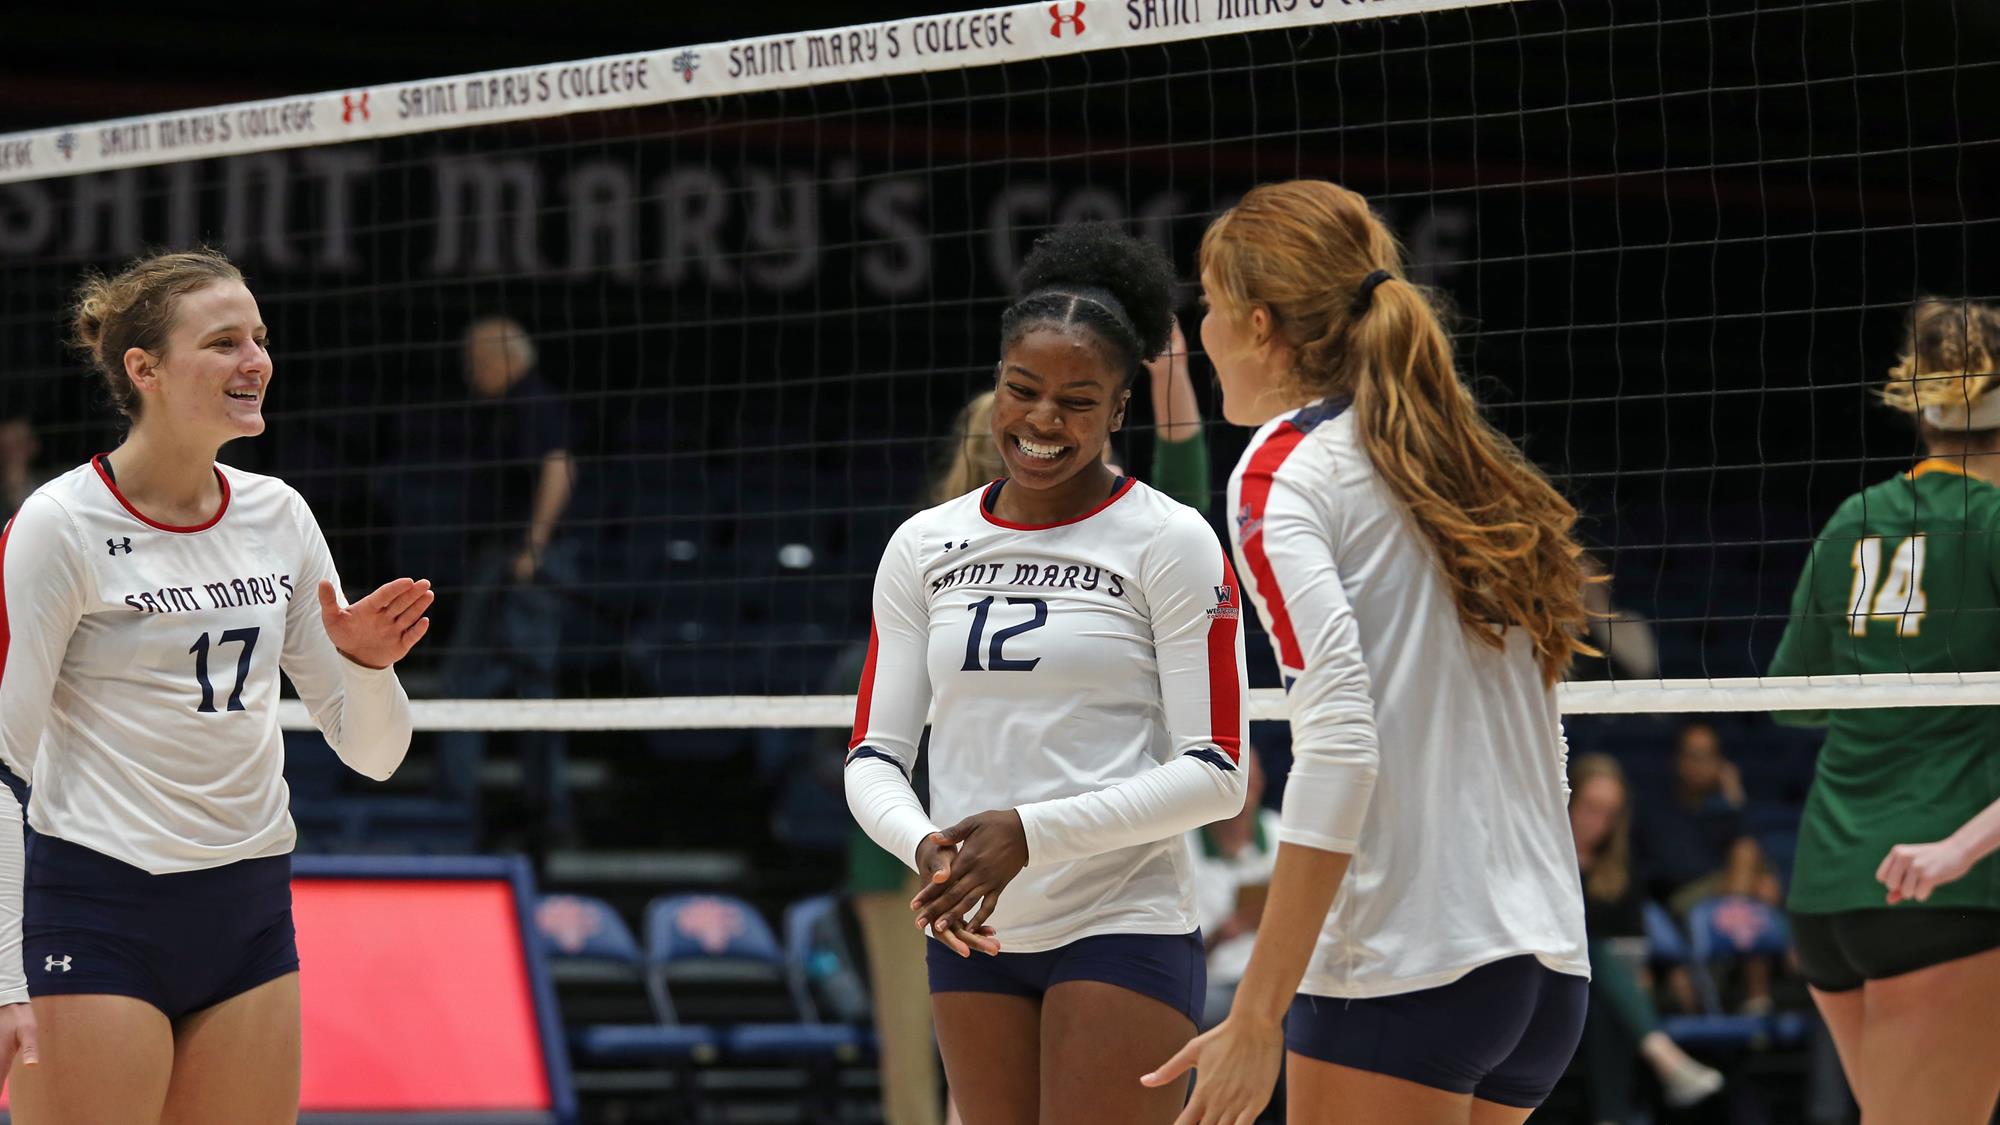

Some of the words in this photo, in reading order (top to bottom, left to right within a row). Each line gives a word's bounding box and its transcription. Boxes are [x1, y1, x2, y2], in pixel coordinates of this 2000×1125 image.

[727, 39, 797, 78] SAINT
[806, 25, 900, 68] MARY'S
[912, 11, 1015, 53] COLLEGE
[400, 82, 458, 119] SAINT
[465, 69, 551, 110] MARY'S
[557, 58, 649, 99] COLLEGE
[99, 122, 150, 157] SAINT
[237, 100, 316, 139] COLLEGE
[430, 156, 929, 293] MARY'S
[124, 586, 201, 613] SAINT
[203, 573, 293, 609] MARY'S
[931, 562, 1004, 595] SAINT
[1009, 562, 1124, 597] MARY'S
[1847, 532, 1927, 637] 14
[960, 595, 1048, 671] 12
[188, 626, 260, 712] 17
